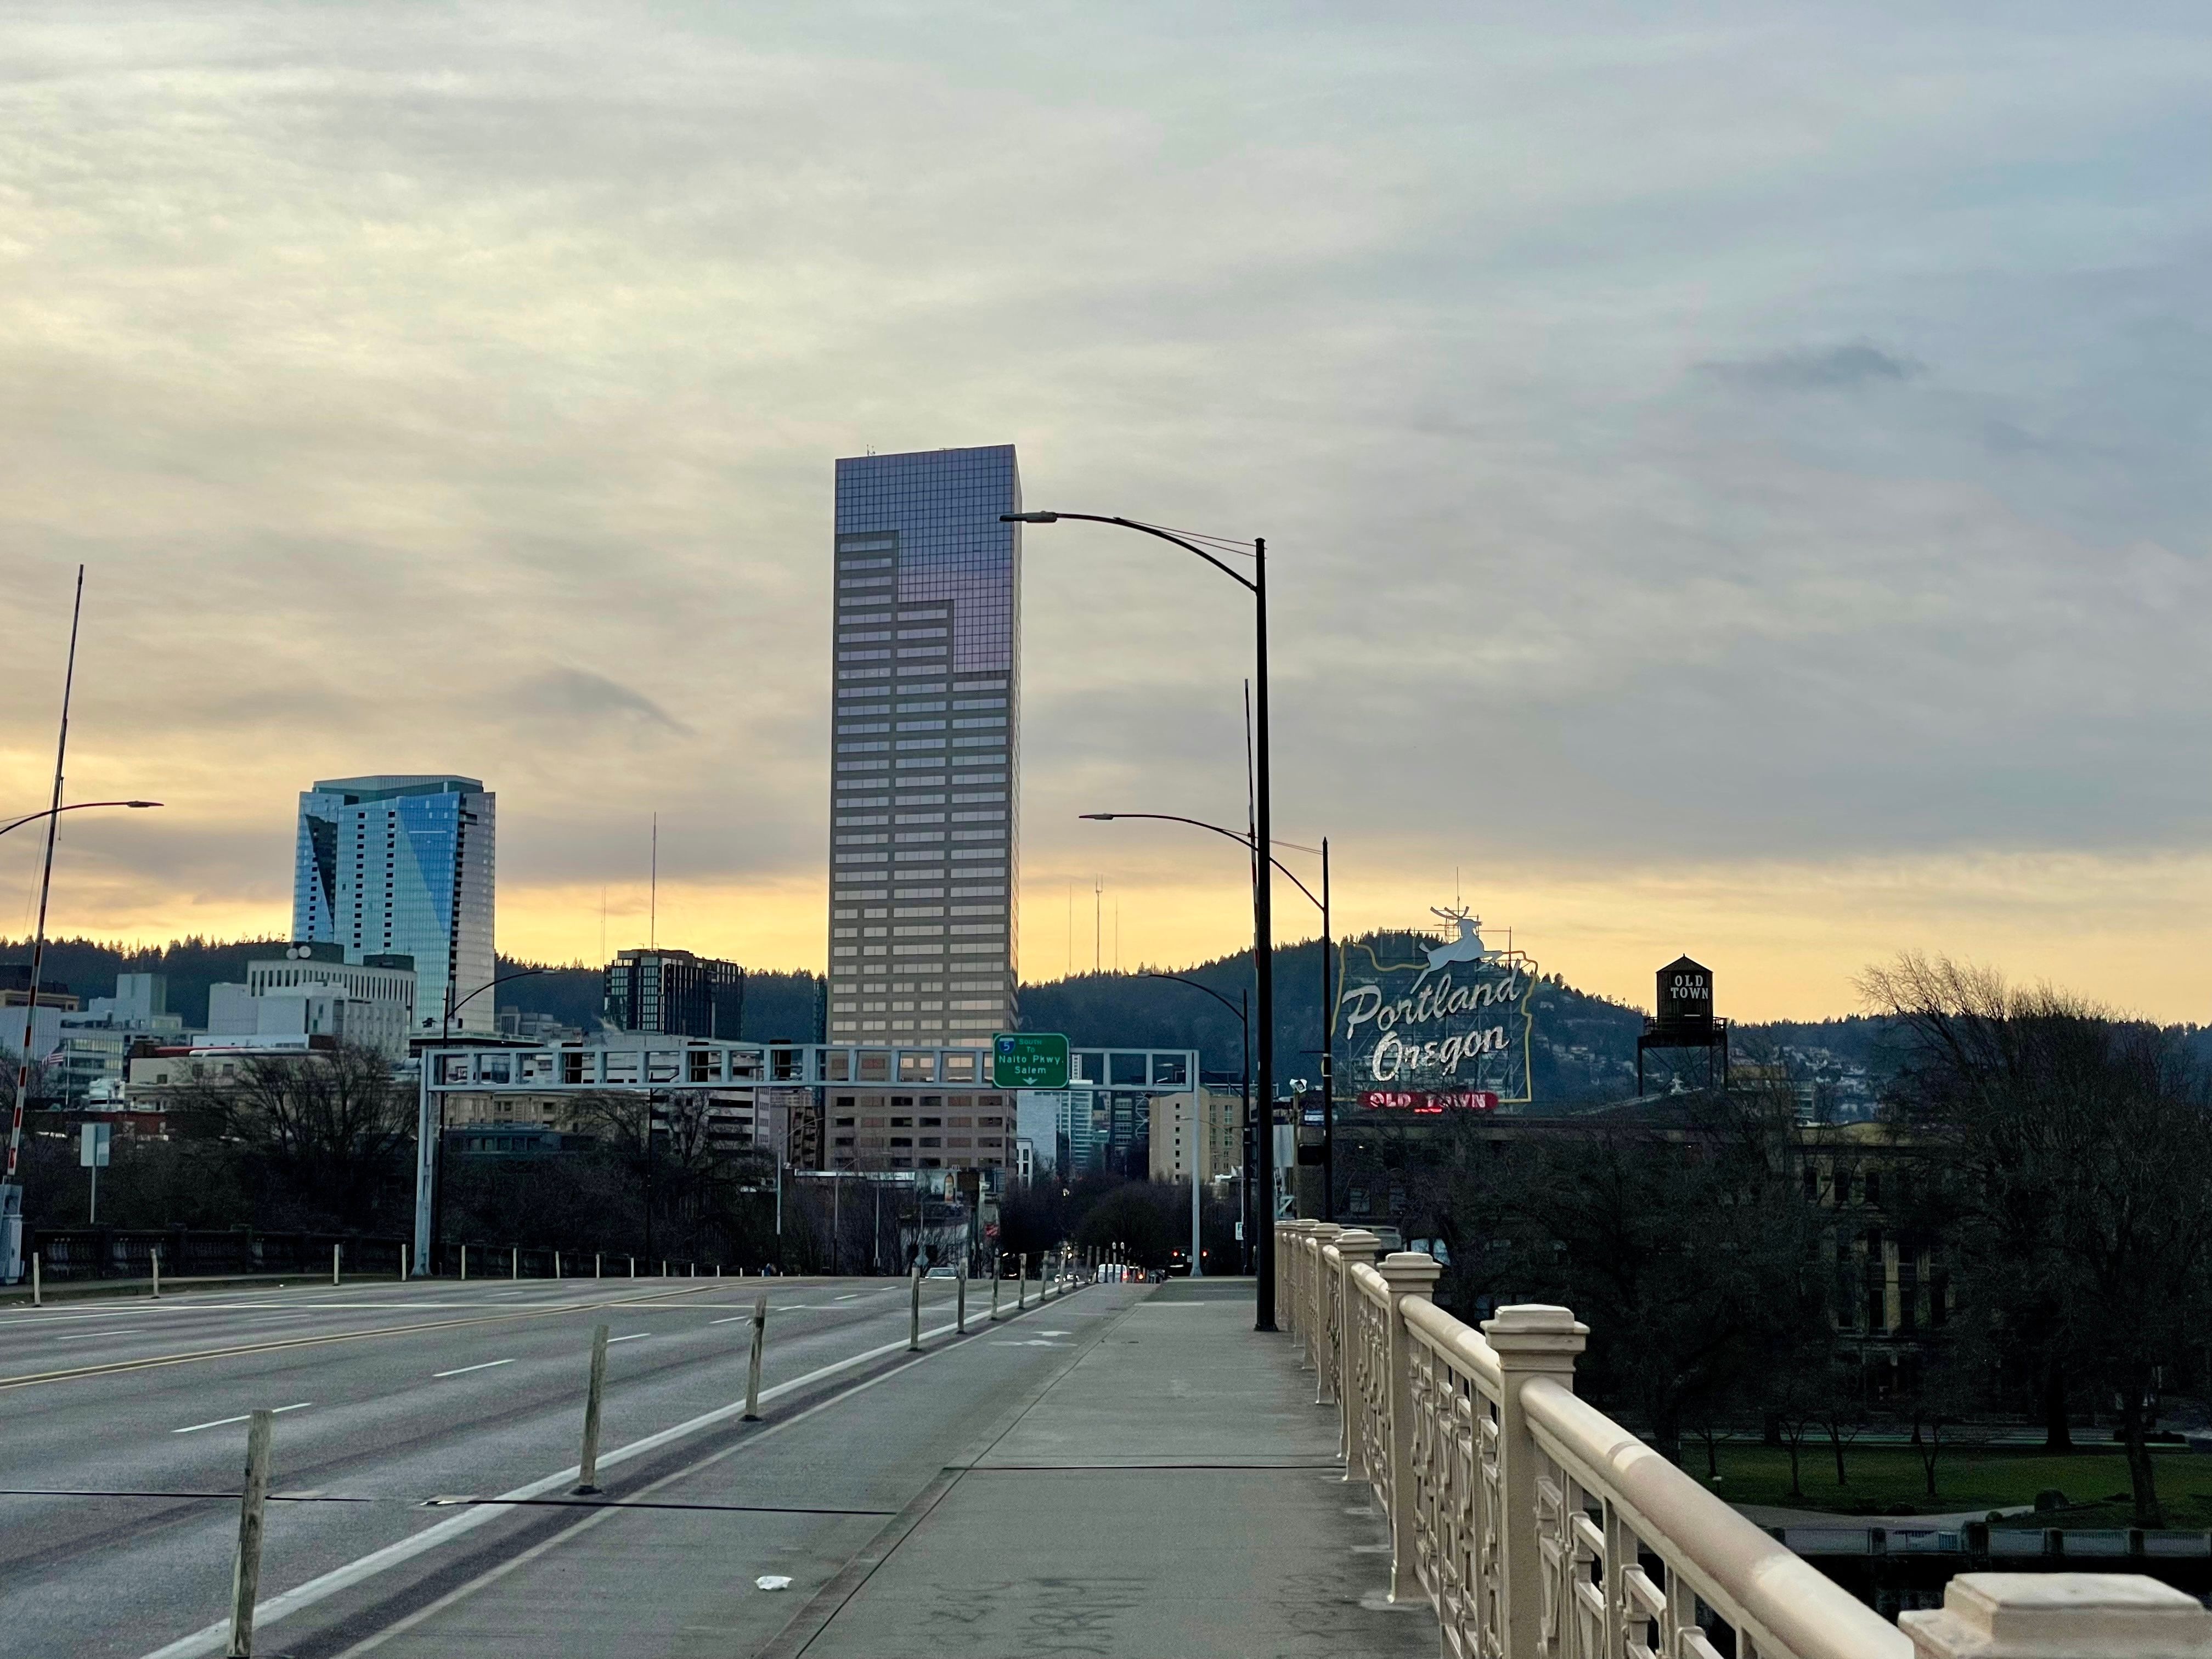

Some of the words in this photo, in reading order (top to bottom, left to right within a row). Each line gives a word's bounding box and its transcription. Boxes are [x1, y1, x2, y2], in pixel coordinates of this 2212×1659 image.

[1674, 974, 1703, 987] OLD
[1342, 958, 1522, 1040] Portland
[1670, 986, 1709, 1000] TOWN
[1003, 1042, 1010, 1051] 5
[1372, 1025, 1510, 1082] Oregon
[1370, 1092, 1411, 1108] OLD
